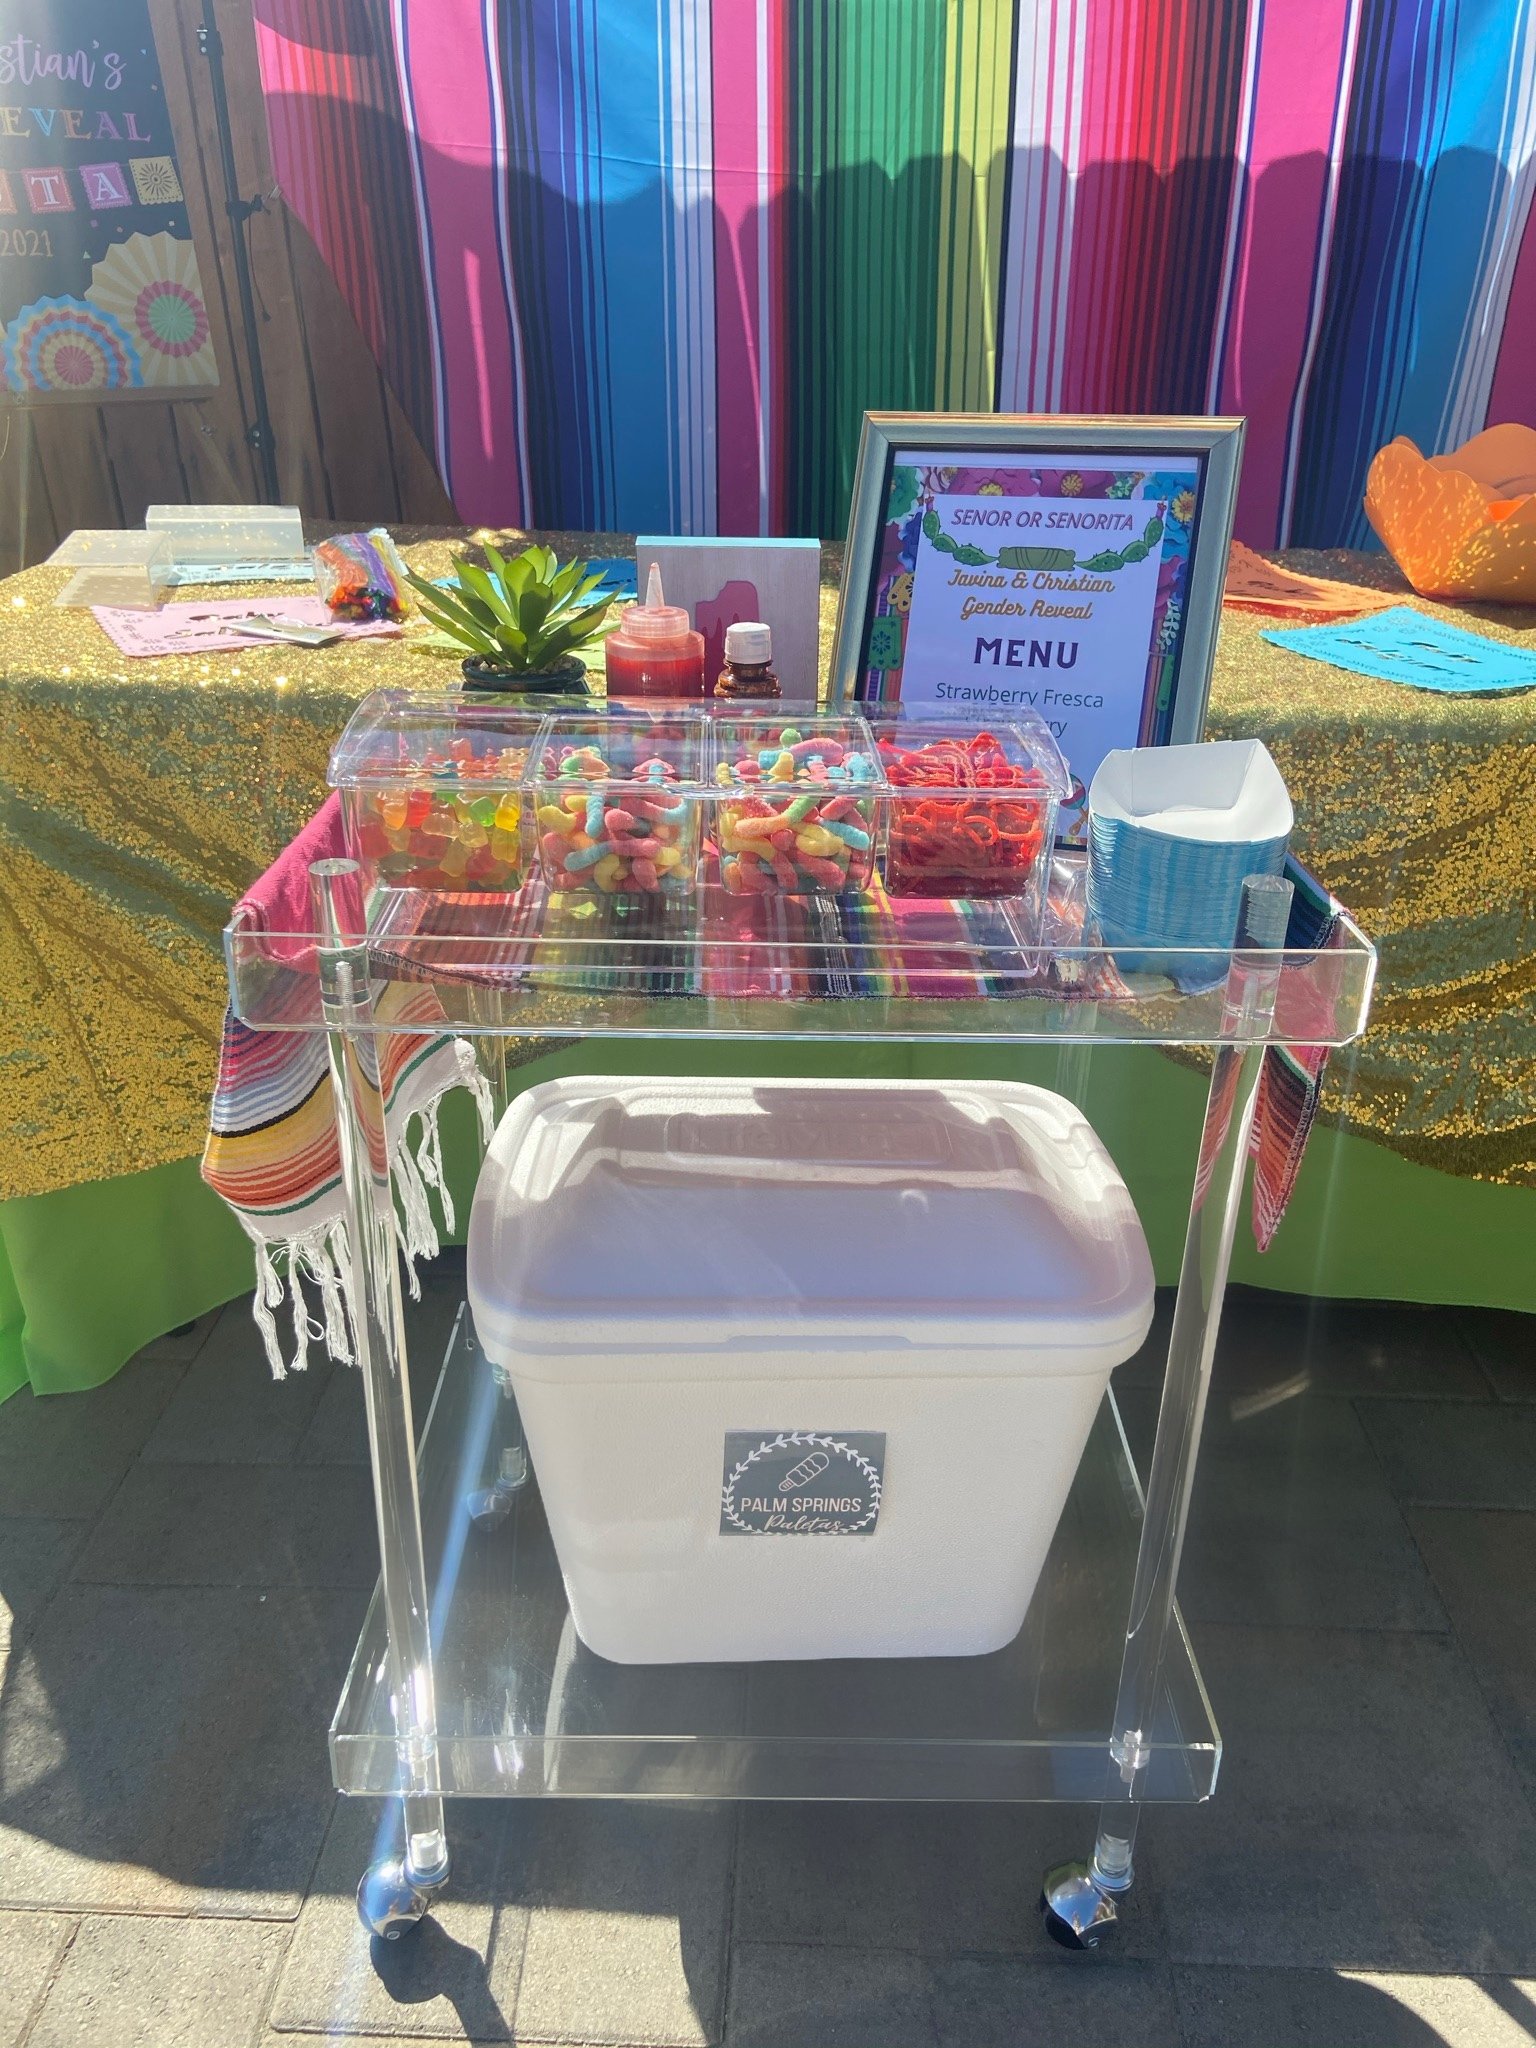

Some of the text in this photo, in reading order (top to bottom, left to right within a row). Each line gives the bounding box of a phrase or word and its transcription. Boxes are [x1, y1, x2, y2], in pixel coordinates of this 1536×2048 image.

[0, 229, 54, 257] 2021
[951, 508, 1134, 531] SENOR OR SENORITA
[1011, 571, 1029, 590] &
[1033, 572, 1115, 593] Christian
[960, 596, 1093, 621] Gender Reveal
[973, 637, 1079, 669] MENU
[935, 682, 1105, 708] Strawberry Fresca
[740, 1497, 862, 1513] PALM SPRINGS
[763, 1514, 845, 1531] Paletas
